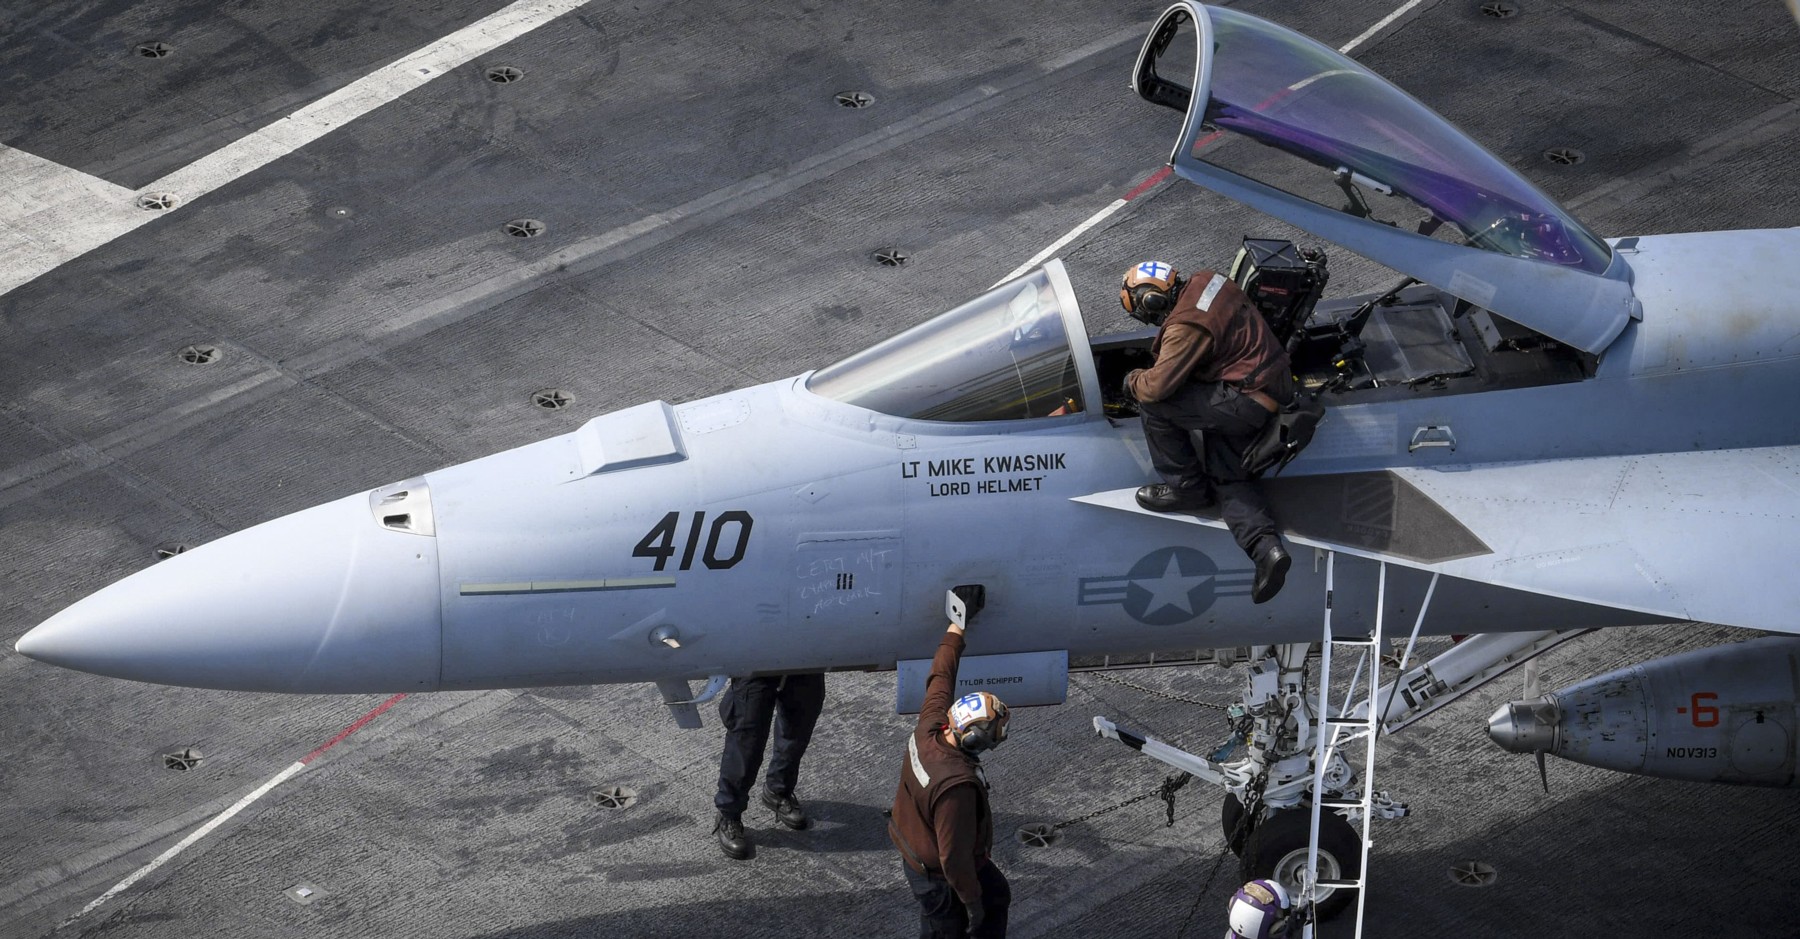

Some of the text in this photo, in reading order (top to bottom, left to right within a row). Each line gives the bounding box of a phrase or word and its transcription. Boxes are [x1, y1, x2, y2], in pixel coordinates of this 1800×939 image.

[902, 453, 1066, 478] LT MIKE KWASNIK
[632, 510, 753, 571] 410
[986, 676, 1023, 685] SCHIPPER
[1677, 692, 1719, 728] -6
[1666, 747, 1717, 759] NOV313
